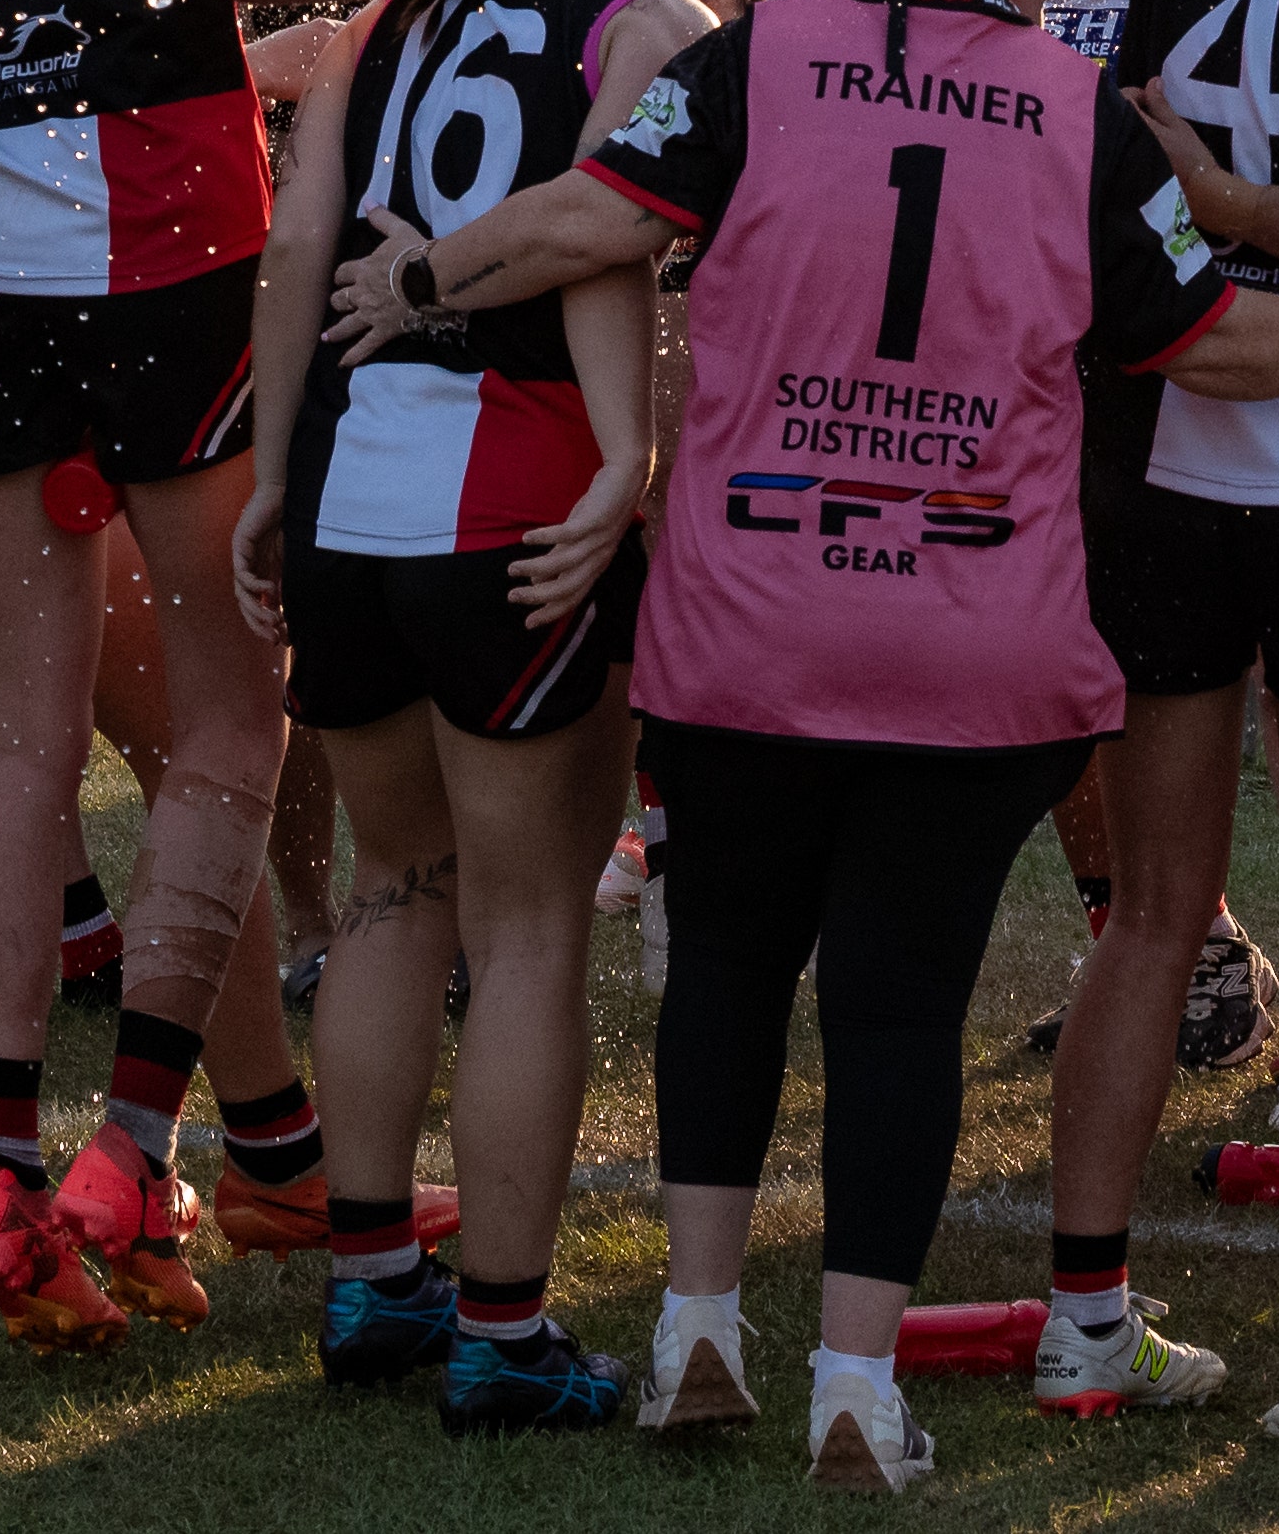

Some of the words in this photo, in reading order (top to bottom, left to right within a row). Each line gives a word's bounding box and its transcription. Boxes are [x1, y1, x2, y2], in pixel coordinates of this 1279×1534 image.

[358, 0, 546, 234] 16
[809, 60, 1046, 136] TRAINER
[875, 143, 947, 364] 1
[775, 372, 998, 431] SOUTHERN
[781, 417, 981, 469] DISTRICTS
[726, 472, 1017, 547] CFS
[822, 543, 918, 577] GEAR
